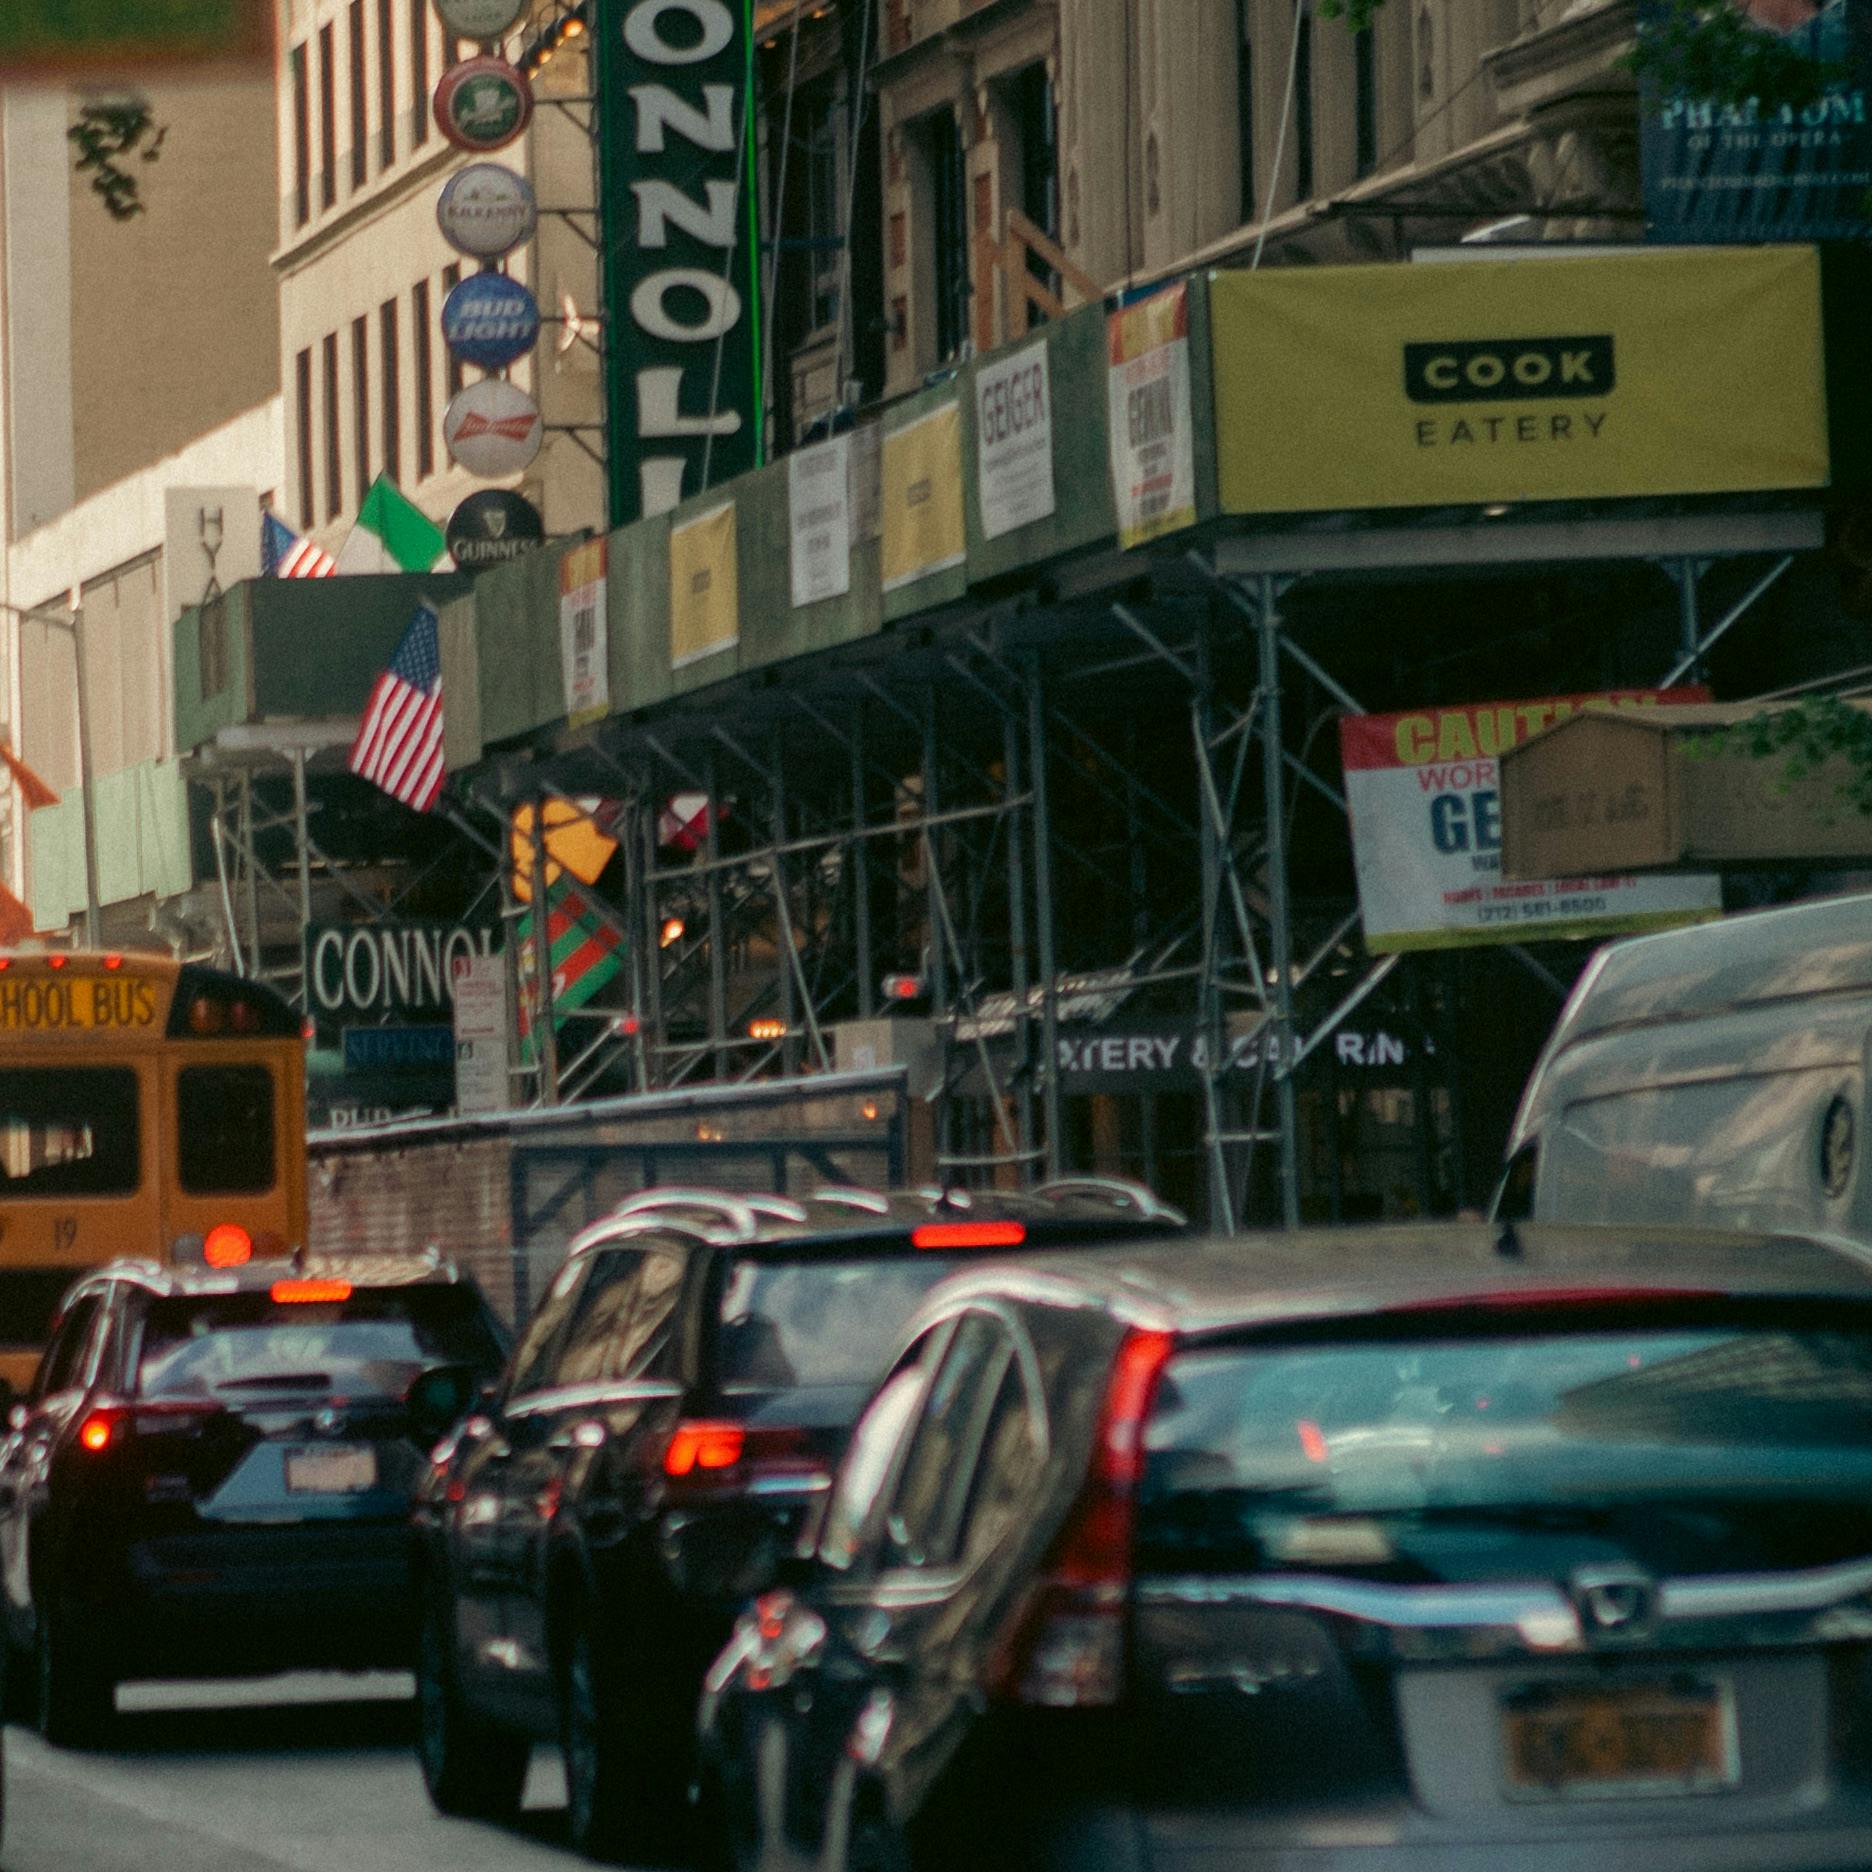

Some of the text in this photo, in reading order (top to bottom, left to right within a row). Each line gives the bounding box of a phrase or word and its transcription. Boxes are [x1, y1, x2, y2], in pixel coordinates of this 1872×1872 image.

[459, 299, 526, 318] BUD
[449, 319, 529, 341] LIGHT
[1423, 349, 1597, 389] COOK
[982, 362, 1046, 446] GEIGER
[1416, 411, 1609, 449] EATERY
[1417, 760, 1497, 793] WOR
[93, 982, 156, 1028] BUS
